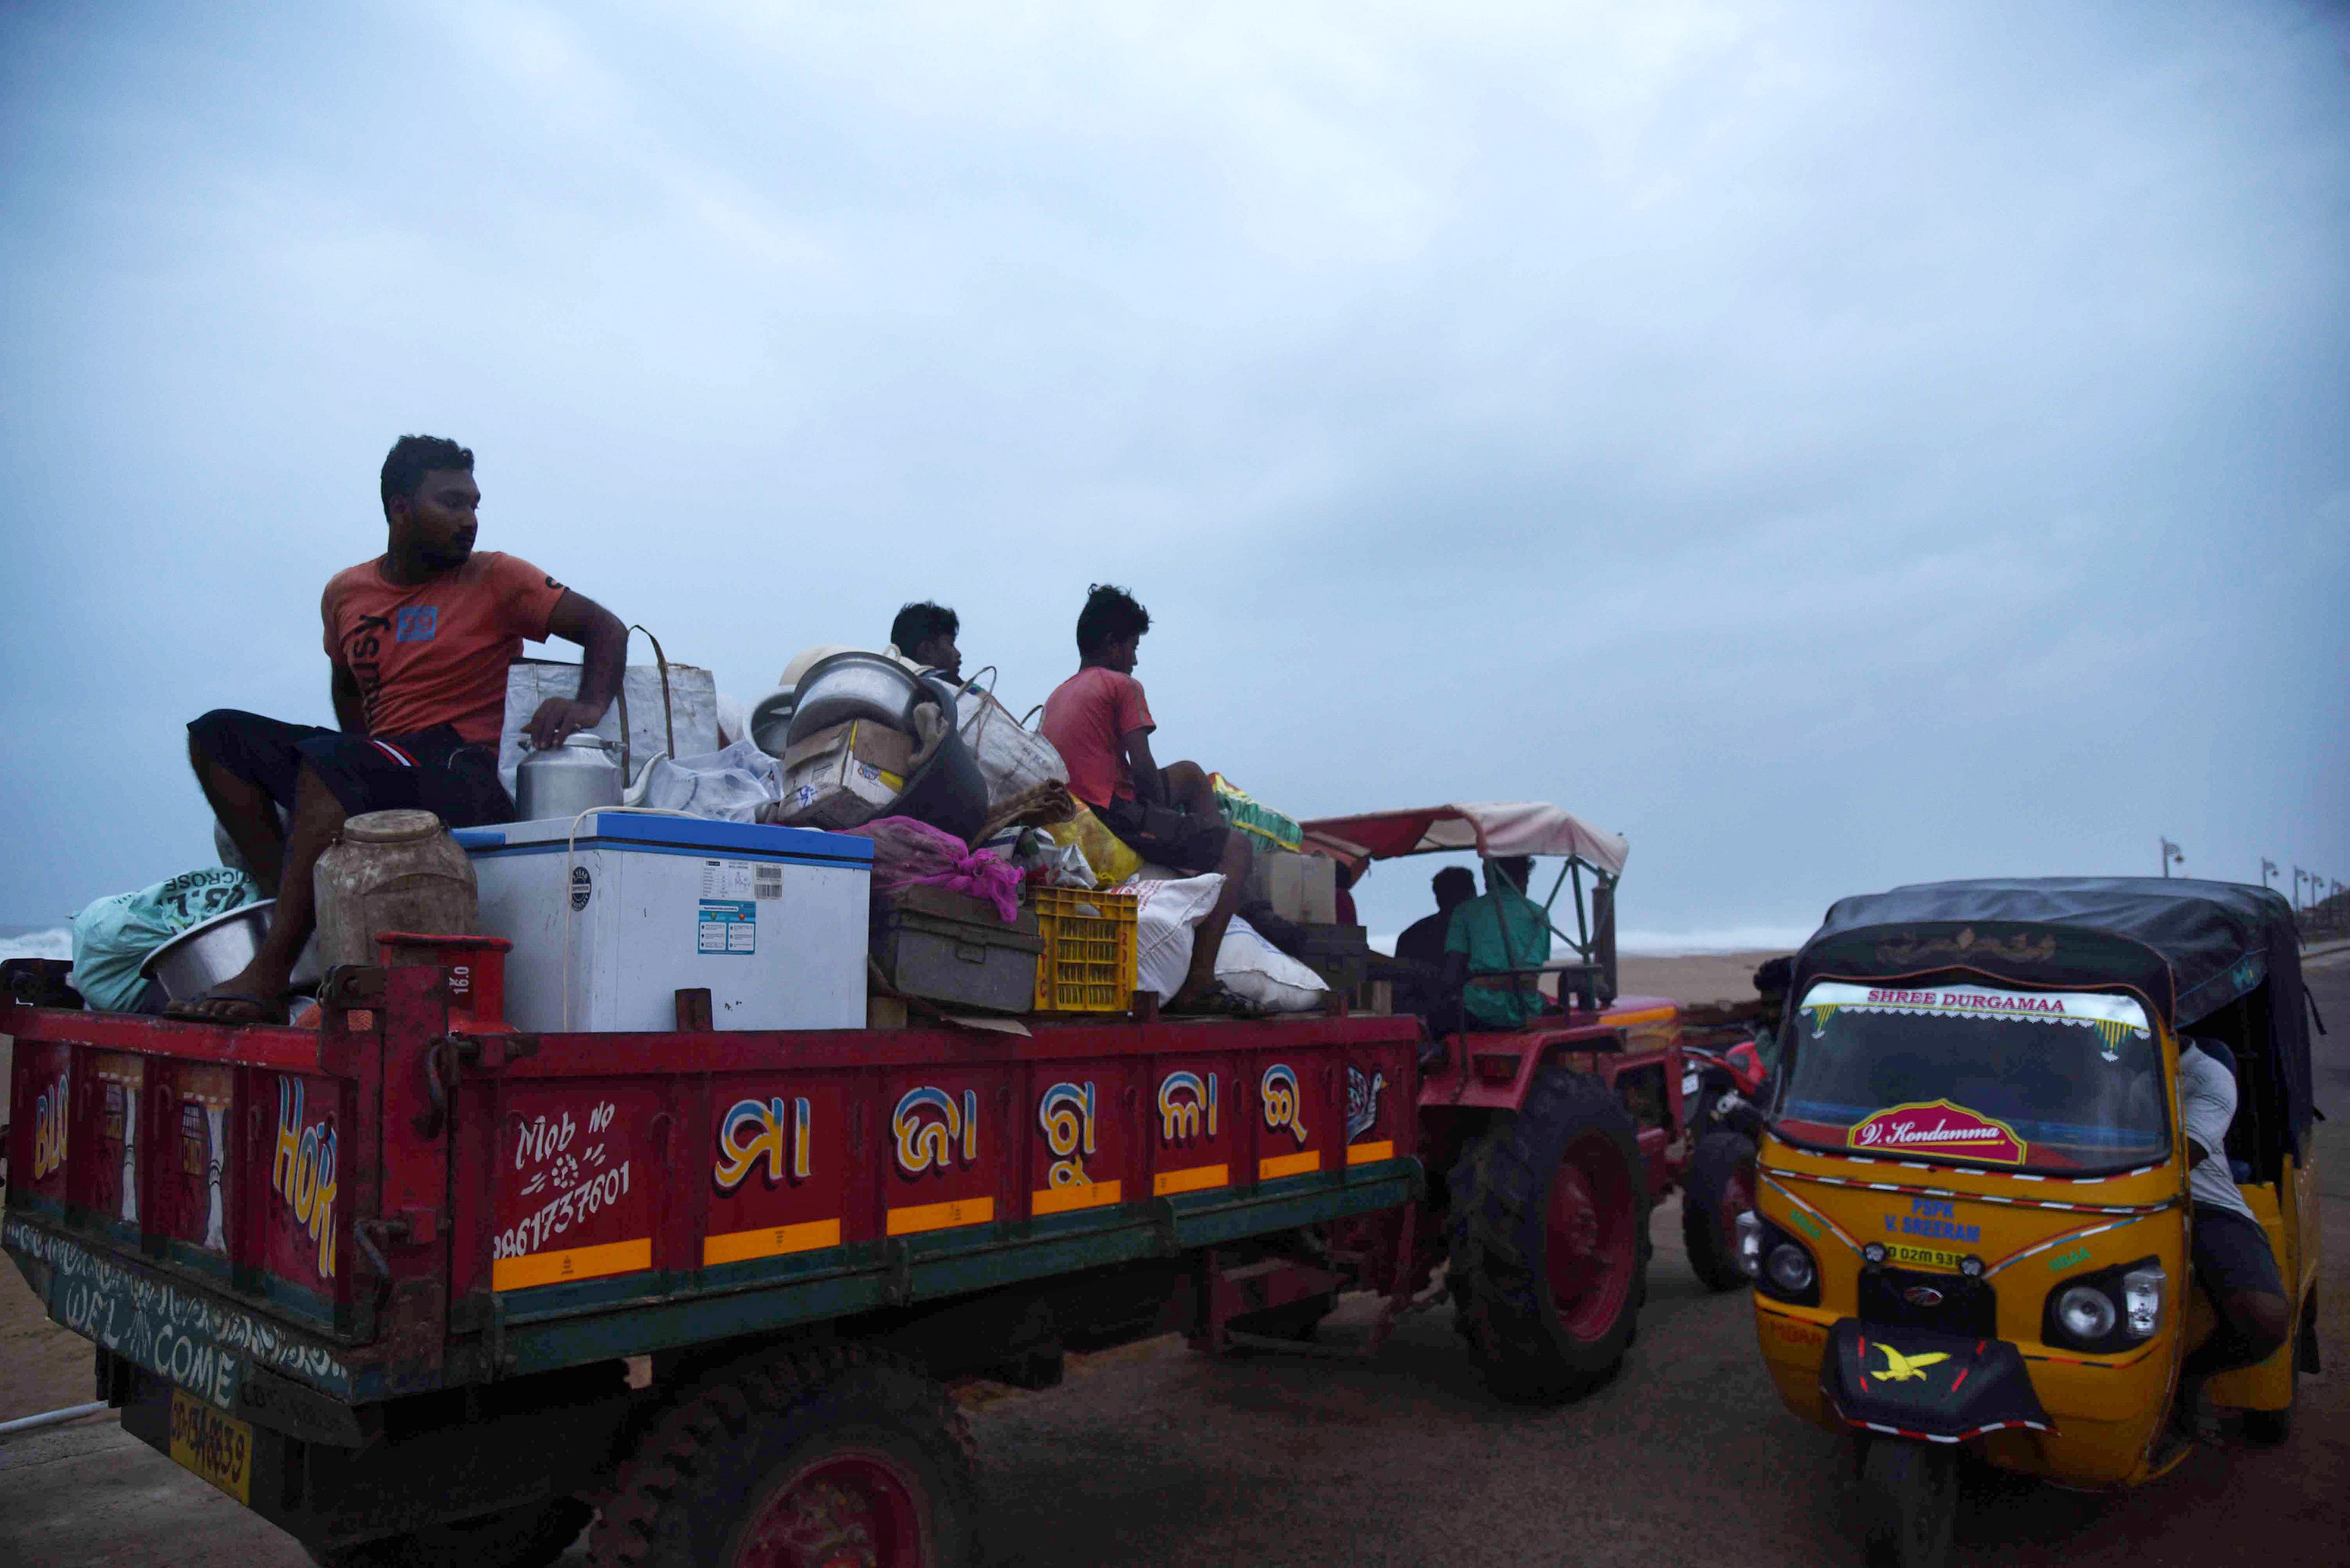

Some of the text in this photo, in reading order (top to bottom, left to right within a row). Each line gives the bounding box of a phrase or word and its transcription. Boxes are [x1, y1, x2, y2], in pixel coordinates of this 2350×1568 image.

[1867, 989, 2066, 1014] SHREE DURGAMAA
[515, 1111, 576, 1170] Mob
[1885, 1118, 2001, 1144] Kondamma
[272, 1074, 338, 1279] HOR
[1912, 1197, 1955, 1218] PSPK
[1901, 1216, 1981, 1243] SREERAM
[153, 1324, 236, 1409] COME
